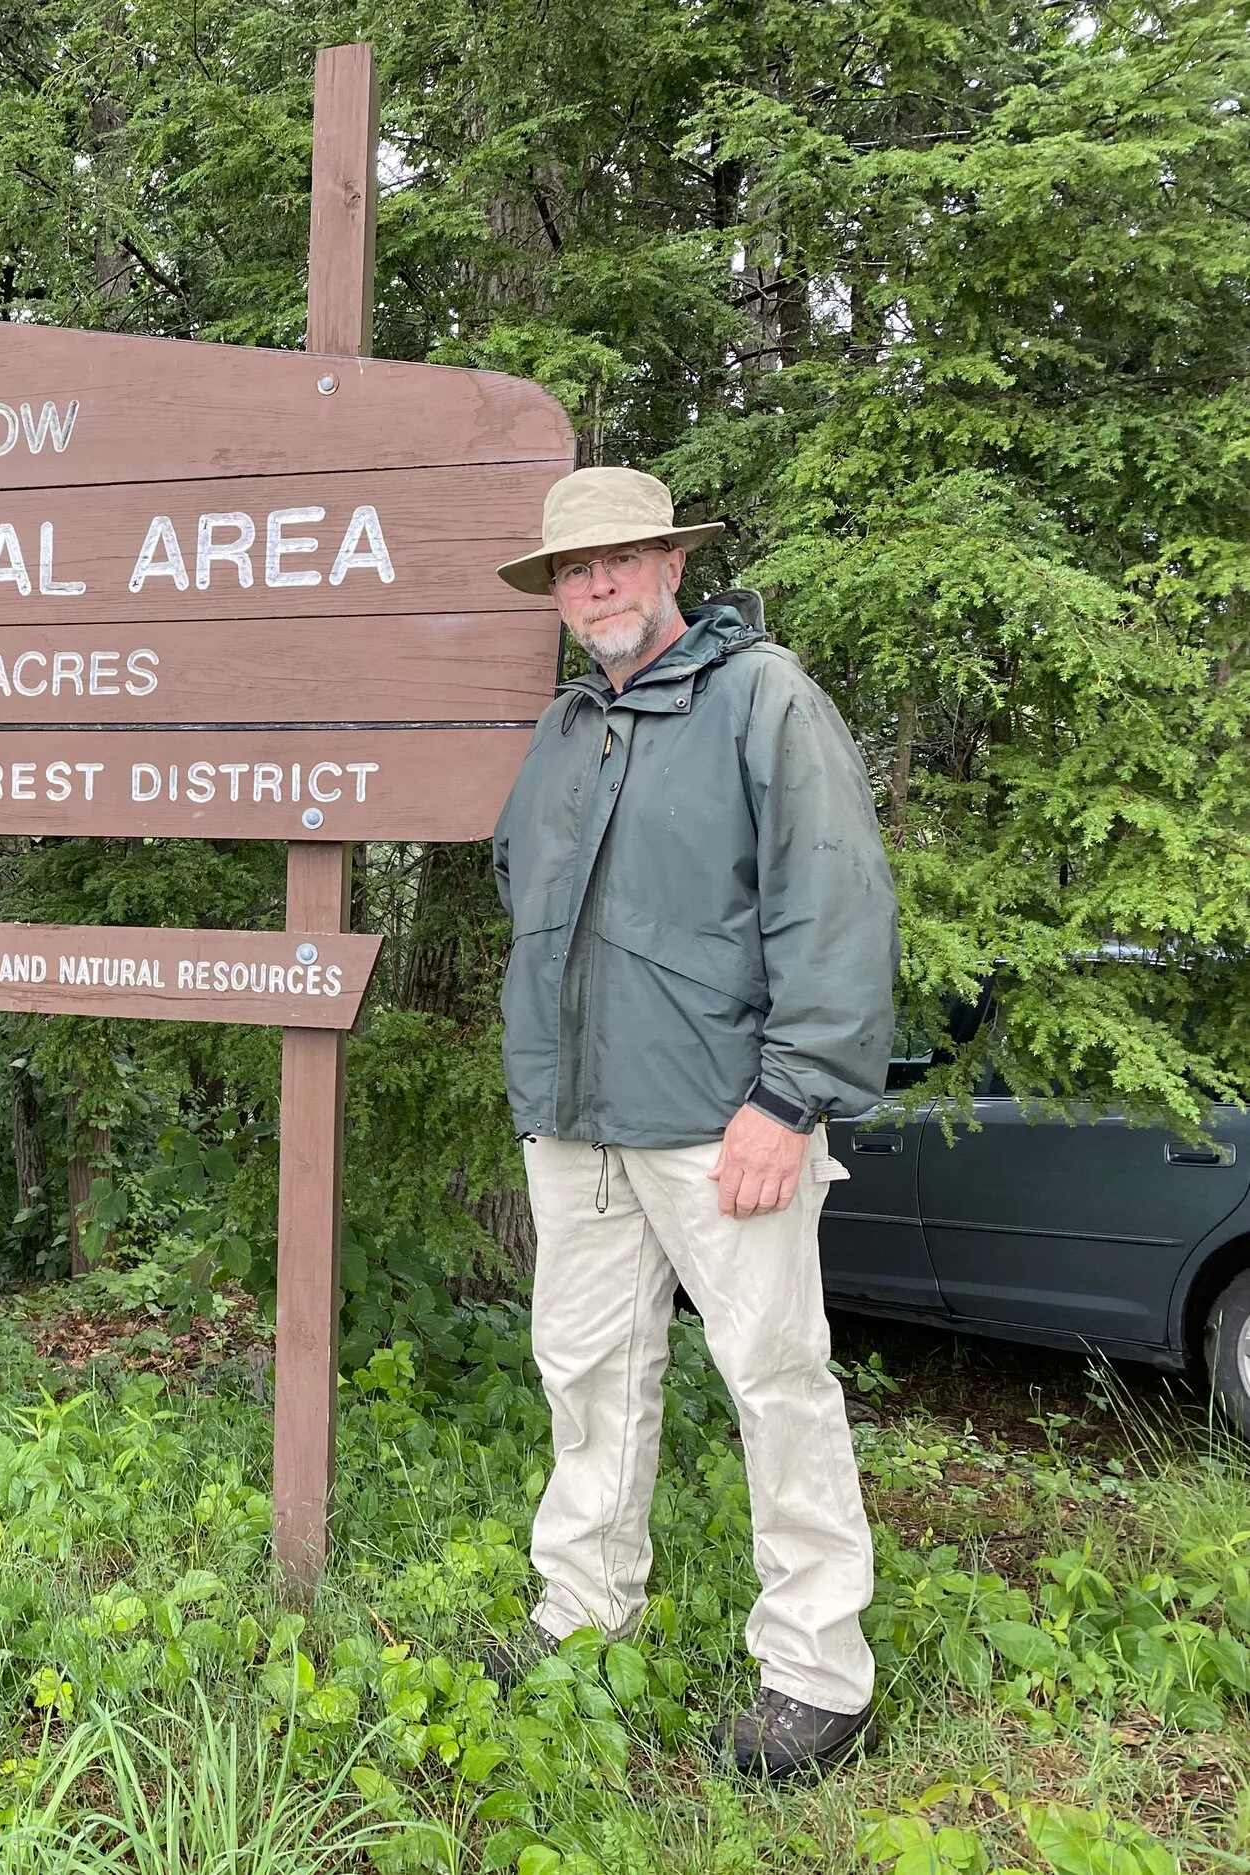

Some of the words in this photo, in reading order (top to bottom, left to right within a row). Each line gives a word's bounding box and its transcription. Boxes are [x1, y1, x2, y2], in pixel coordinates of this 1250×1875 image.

[128, 505, 395, 593] AREA
[131, 761, 380, 803] DISTRICT
[59, 955, 166, 989] NATURAL
[178, 960, 343, 997] RESOURCES
